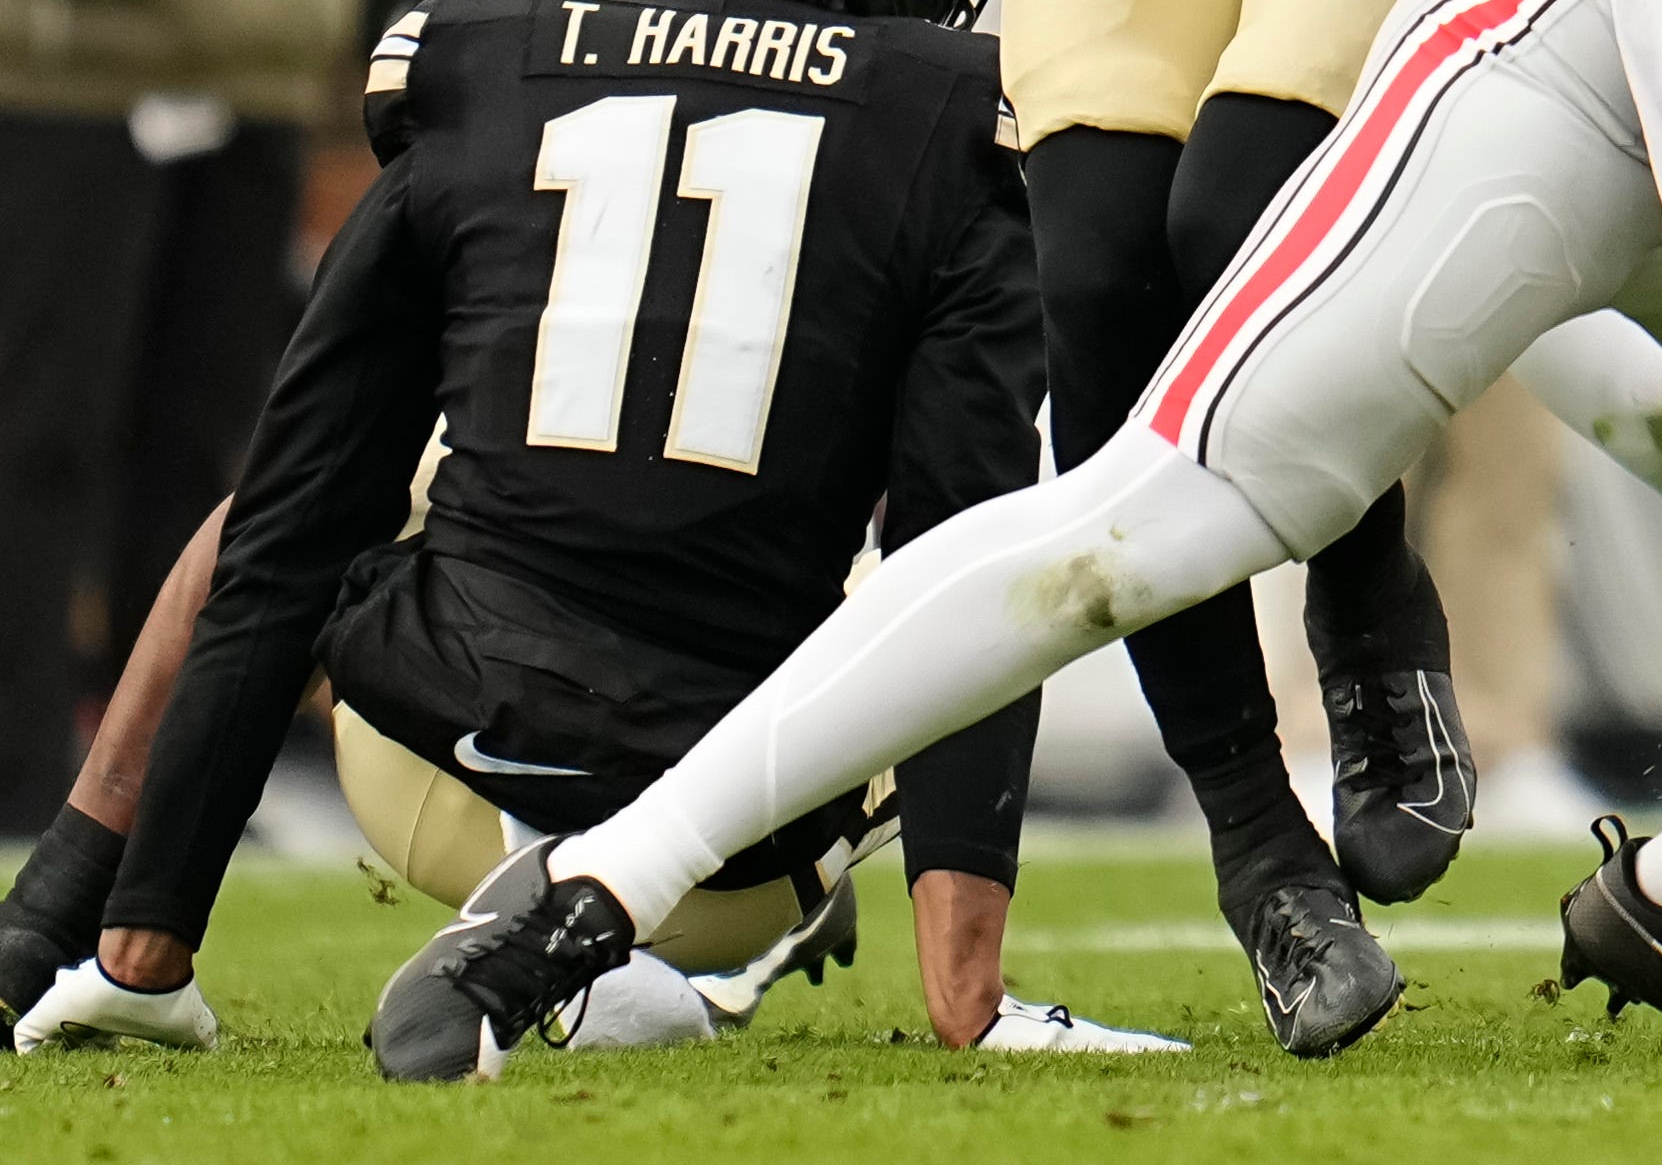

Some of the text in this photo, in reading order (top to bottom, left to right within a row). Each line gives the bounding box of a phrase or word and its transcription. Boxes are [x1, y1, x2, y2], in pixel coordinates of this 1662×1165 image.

[560, 0, 857, 87] T. HARRIS
[525, 93, 827, 477] 11
